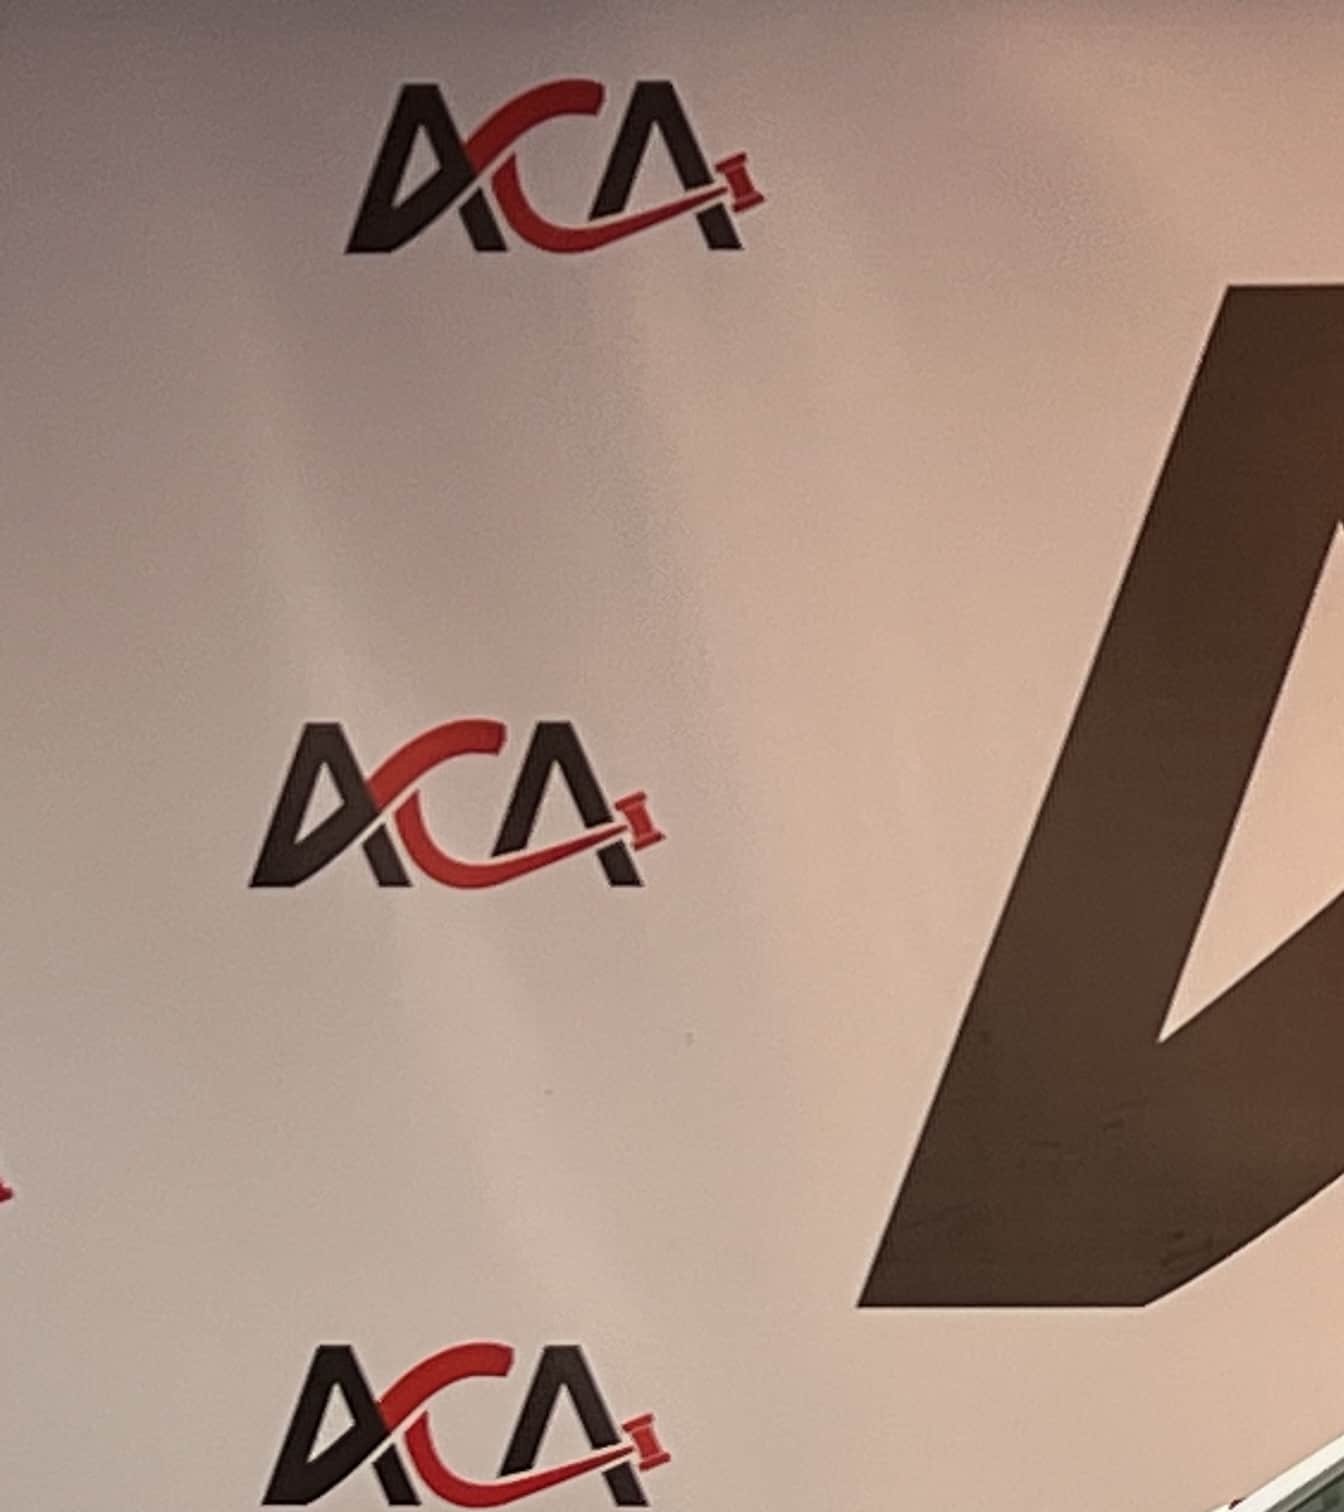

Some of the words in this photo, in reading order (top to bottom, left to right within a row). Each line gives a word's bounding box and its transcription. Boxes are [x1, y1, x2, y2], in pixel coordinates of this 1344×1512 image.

[344, 78, 743, 256] ACA
[248, 720, 643, 888] ACA
[262, 1343, 649, 1507] ACA
